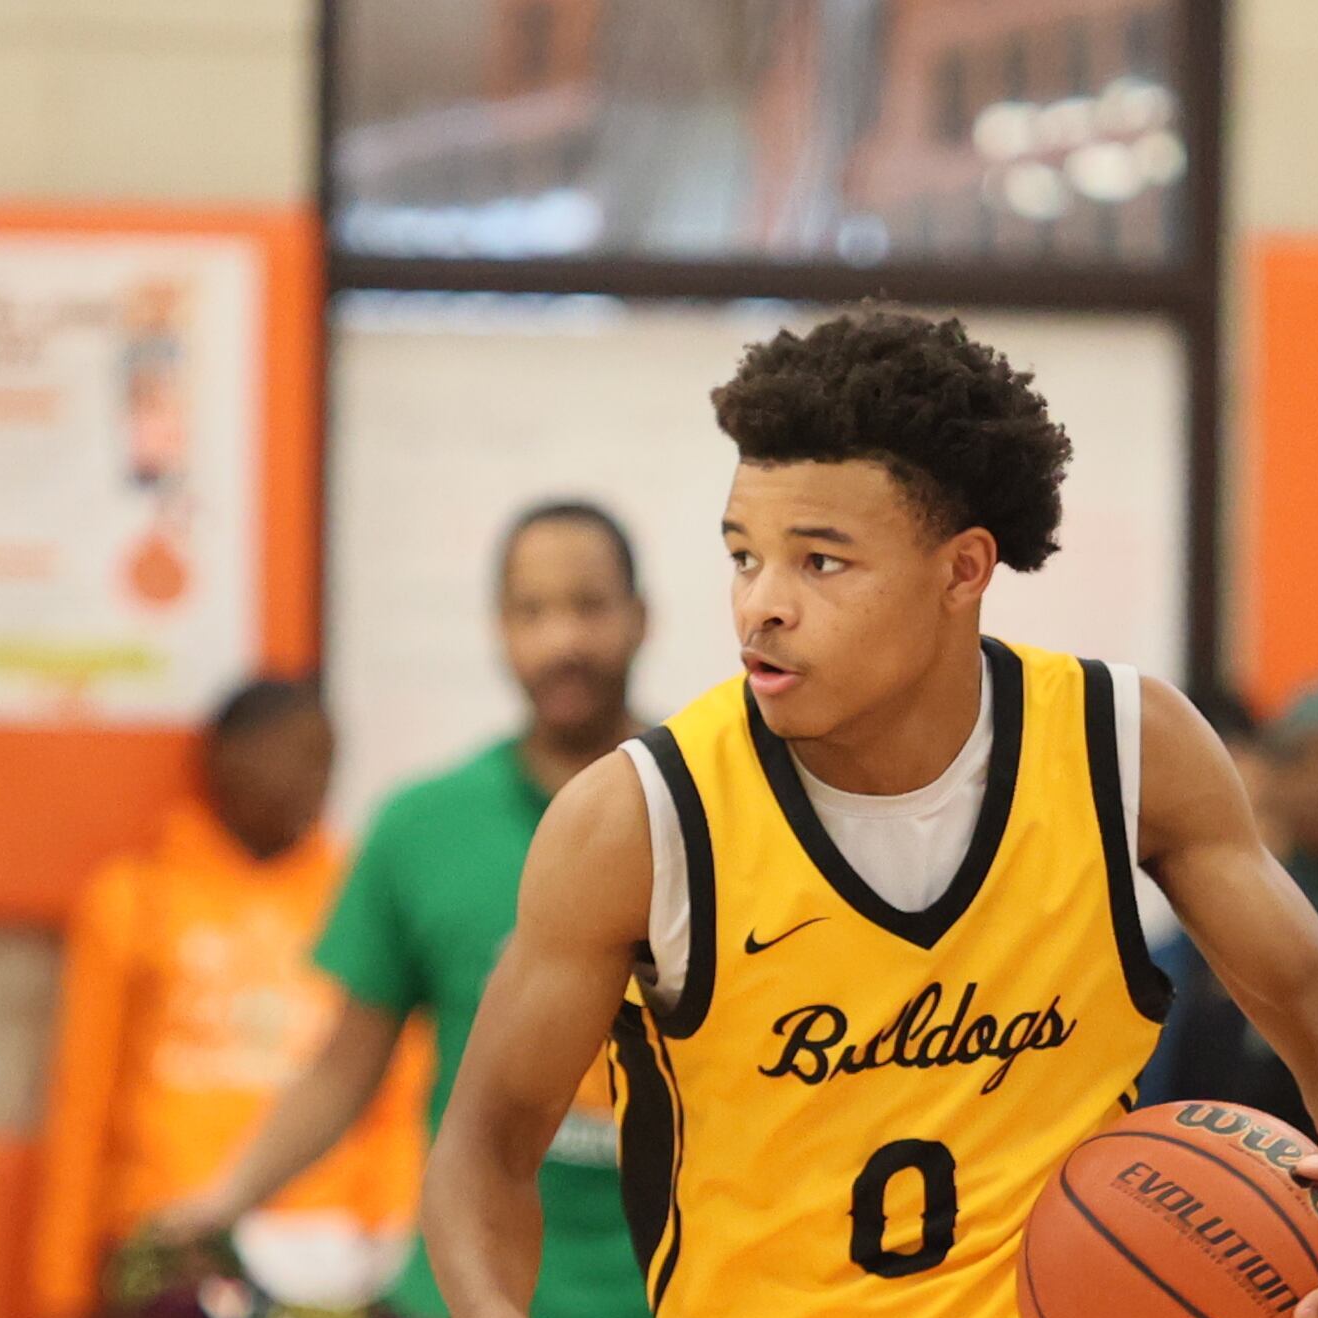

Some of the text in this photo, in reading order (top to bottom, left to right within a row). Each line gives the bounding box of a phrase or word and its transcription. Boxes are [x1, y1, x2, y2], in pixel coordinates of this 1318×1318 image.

[757, 981, 1078, 1095] Bulldogs
[849, 1138, 959, 1279] 0
[1115, 1161, 1300, 1314] EVOLUTION
